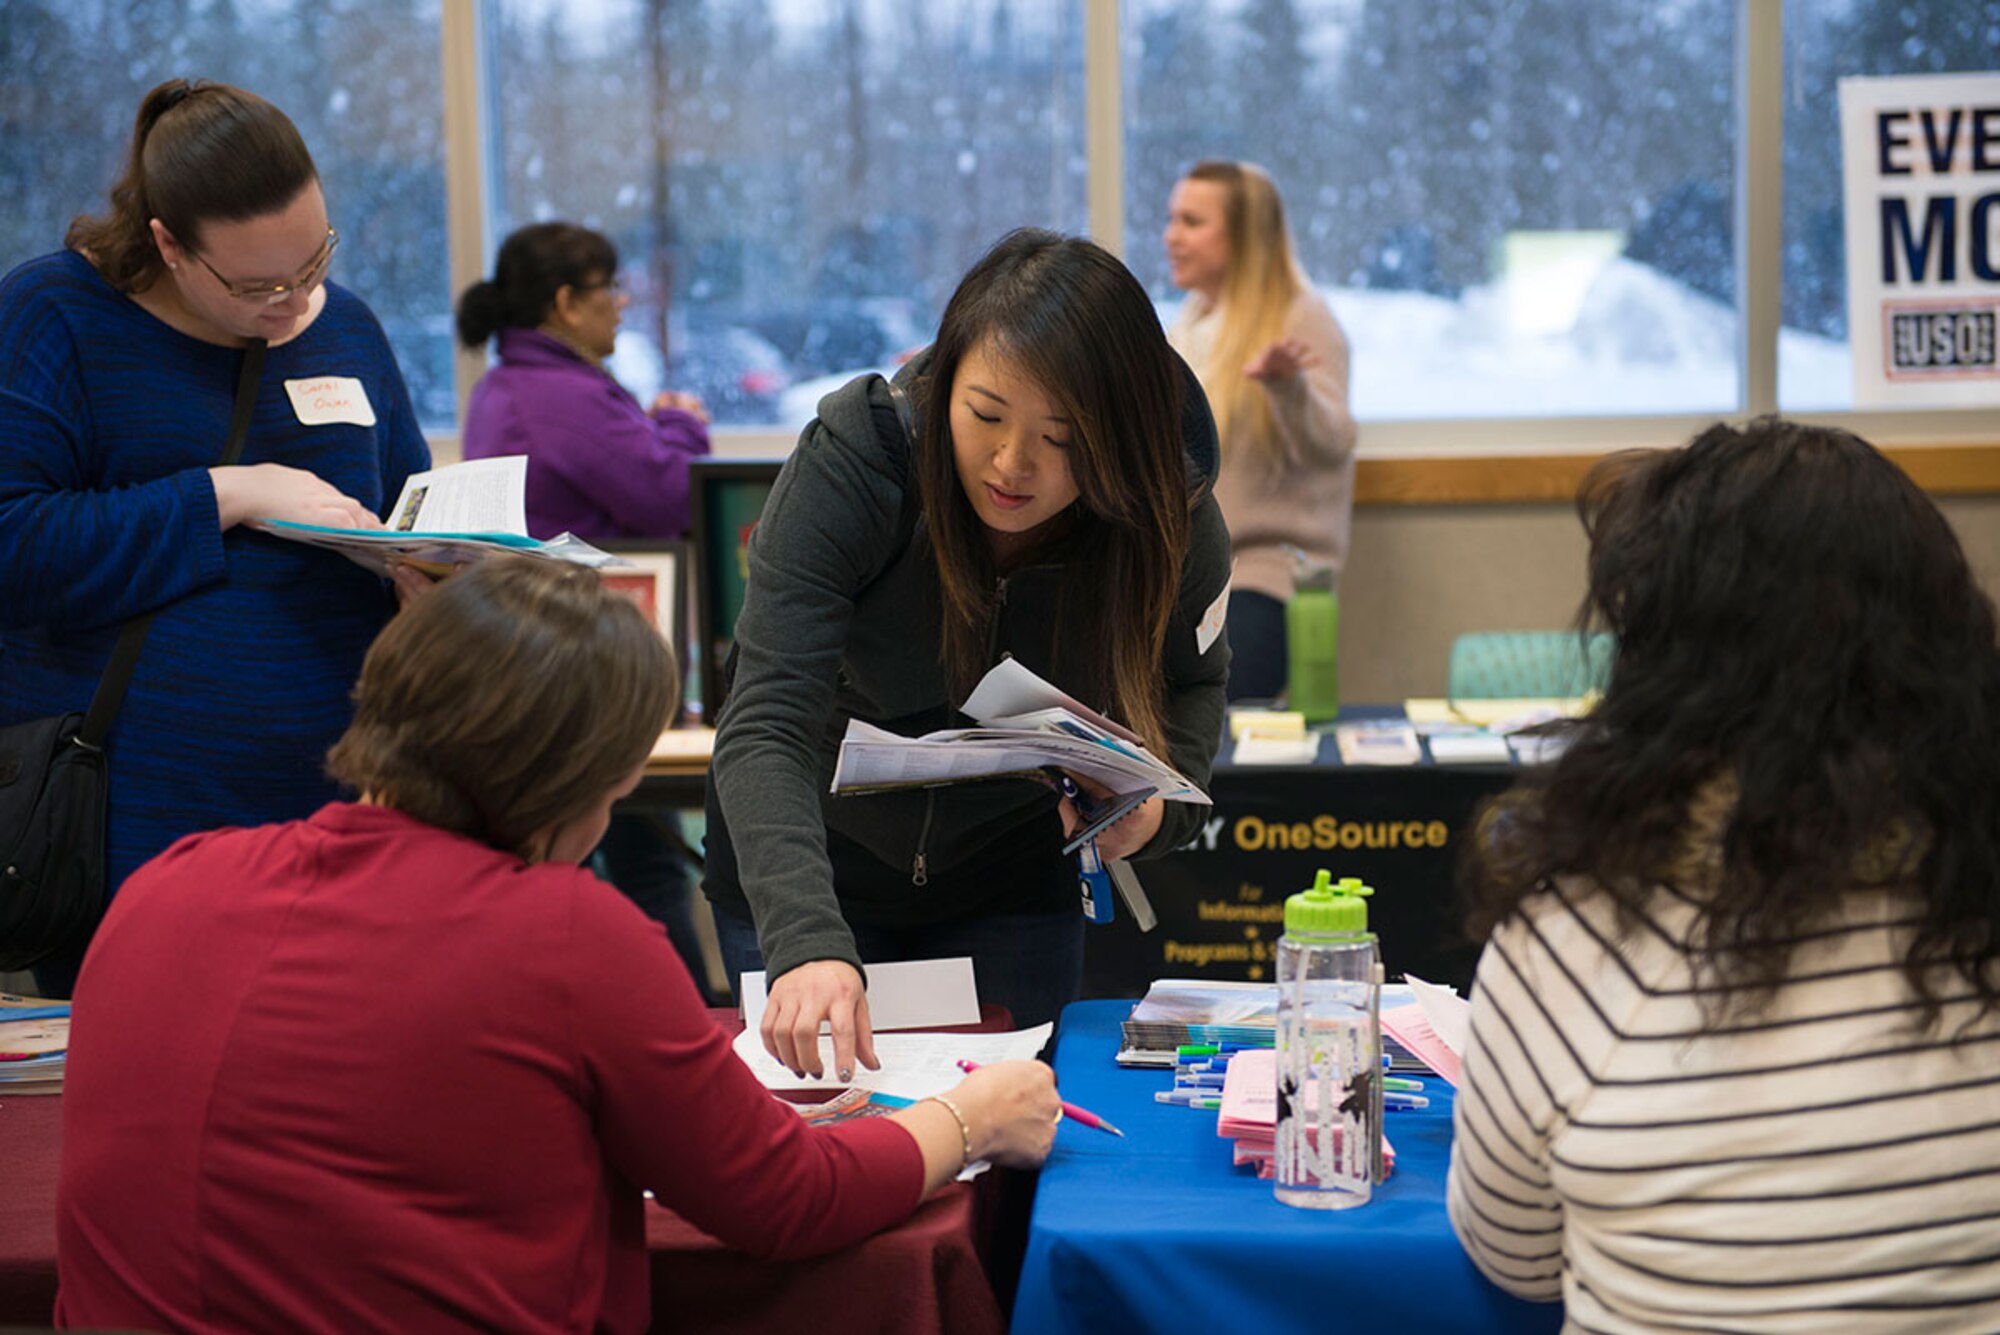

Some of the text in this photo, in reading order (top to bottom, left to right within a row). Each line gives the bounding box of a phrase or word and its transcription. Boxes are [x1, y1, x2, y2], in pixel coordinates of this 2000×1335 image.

[1909, 314, 1978, 366] USO
[1233, 815, 1448, 850] OneSource
[1164, 941, 1249, 965] Programs
[1254, 942, 1267, 959] &
